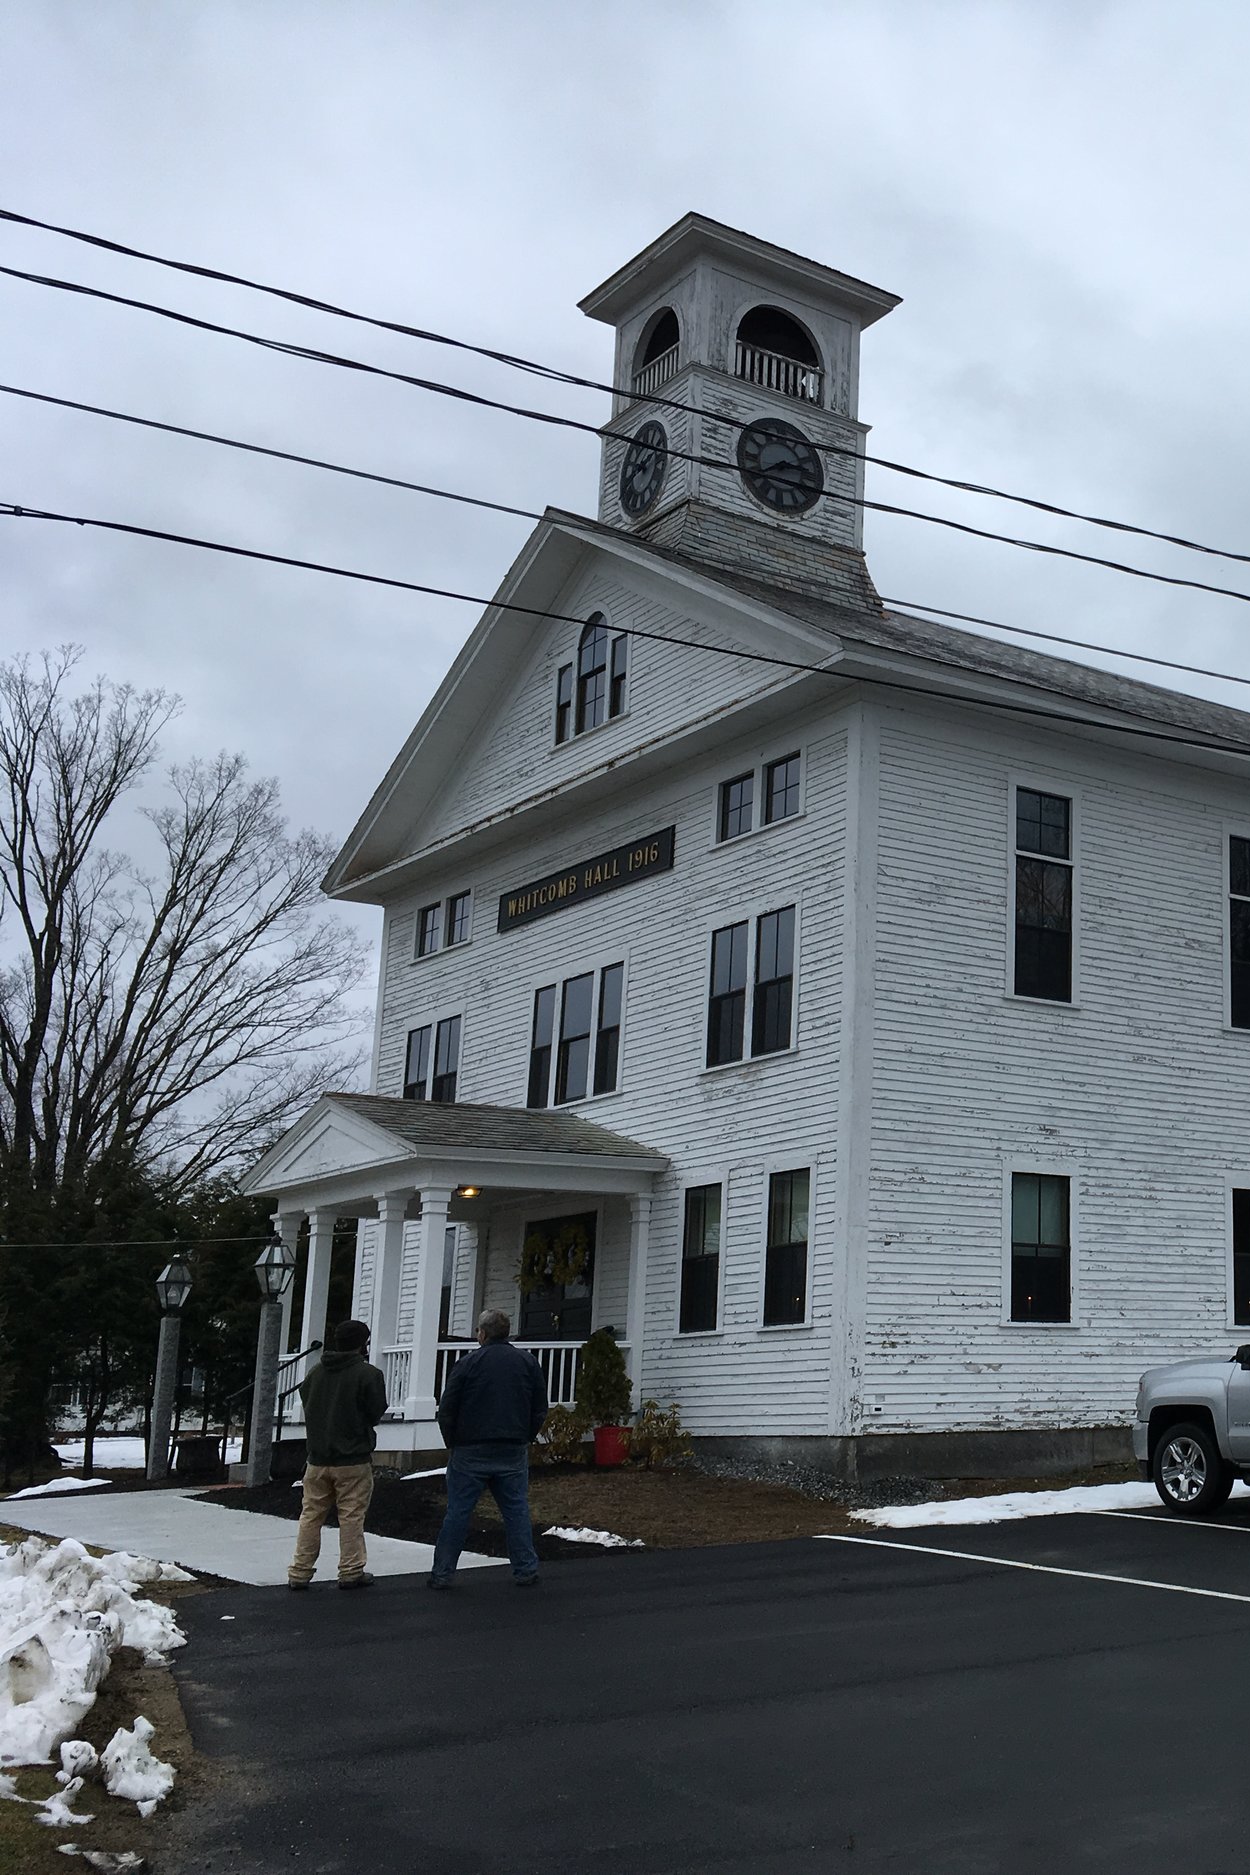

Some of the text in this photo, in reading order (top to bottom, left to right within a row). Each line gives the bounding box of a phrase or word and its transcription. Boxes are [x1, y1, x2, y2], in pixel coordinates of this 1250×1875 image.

[508, 842, 659, 917] WHITCOMB HALL 1916
